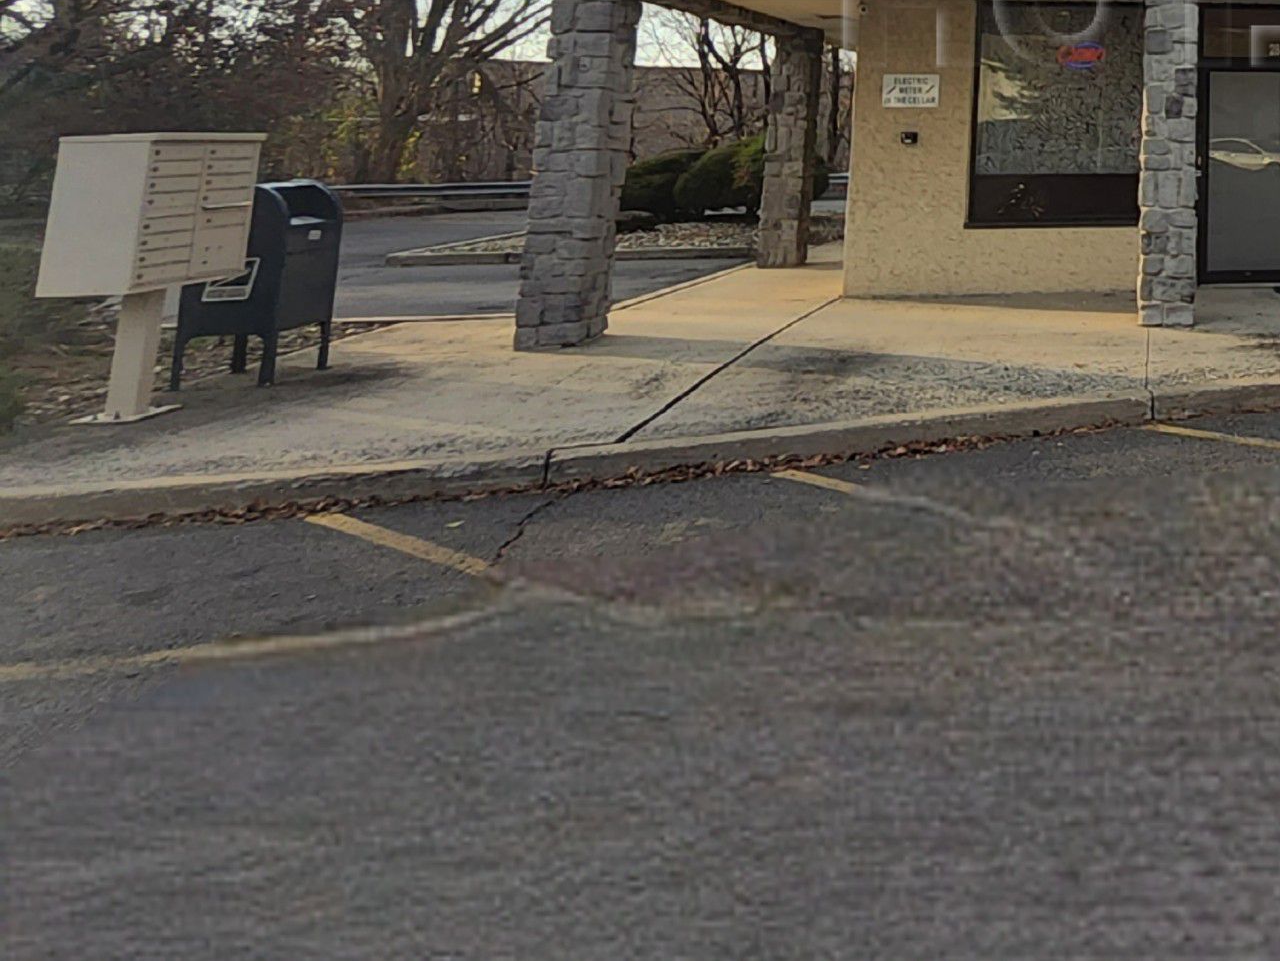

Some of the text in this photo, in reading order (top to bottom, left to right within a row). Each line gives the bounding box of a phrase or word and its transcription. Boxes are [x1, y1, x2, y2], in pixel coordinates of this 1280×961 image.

[893, 77, 929, 85] ELECTRIC
[898, 86, 923, 95] METER
[907, 96, 937, 104] CELLAR
